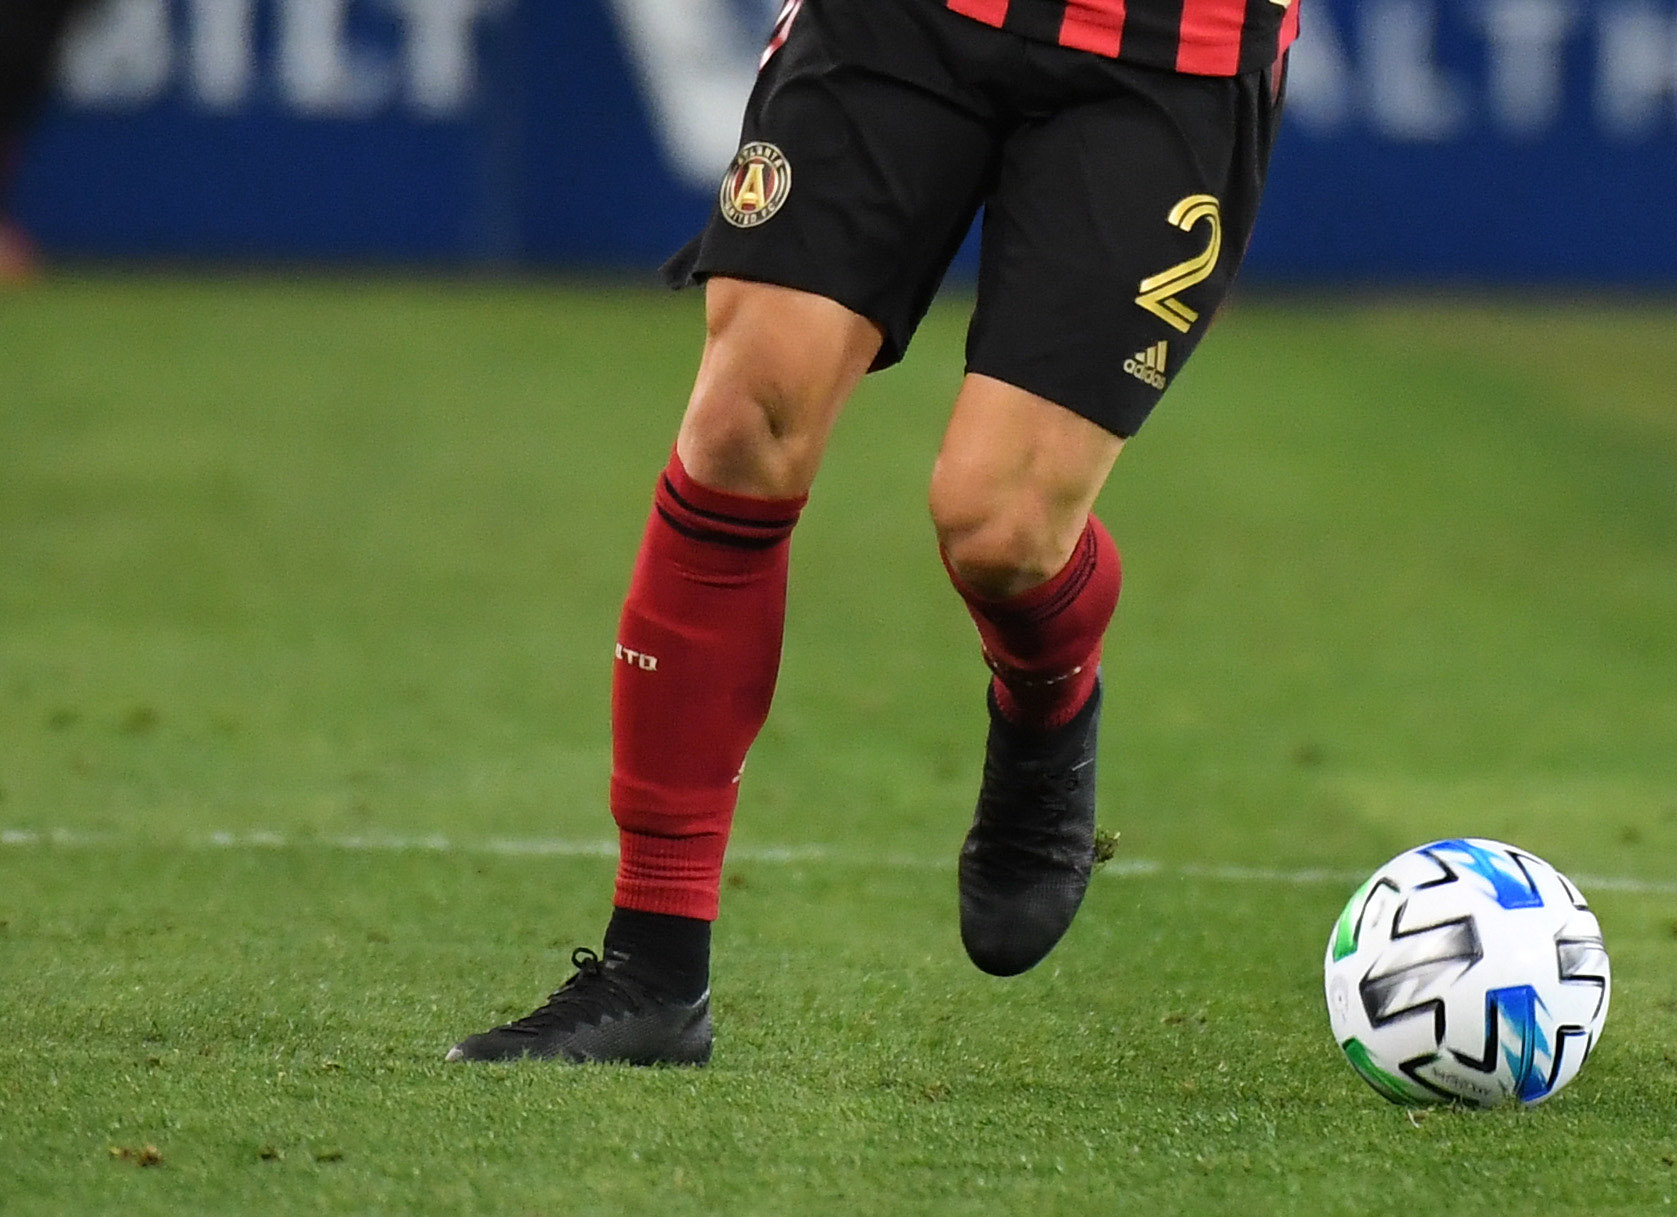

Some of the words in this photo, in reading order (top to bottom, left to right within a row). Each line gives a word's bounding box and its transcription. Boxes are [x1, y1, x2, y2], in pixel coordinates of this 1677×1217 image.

[735, 163, 765, 212] A
[1135, 194, 1221, 334] 2
[1123, 358, 1167, 391] adidas
